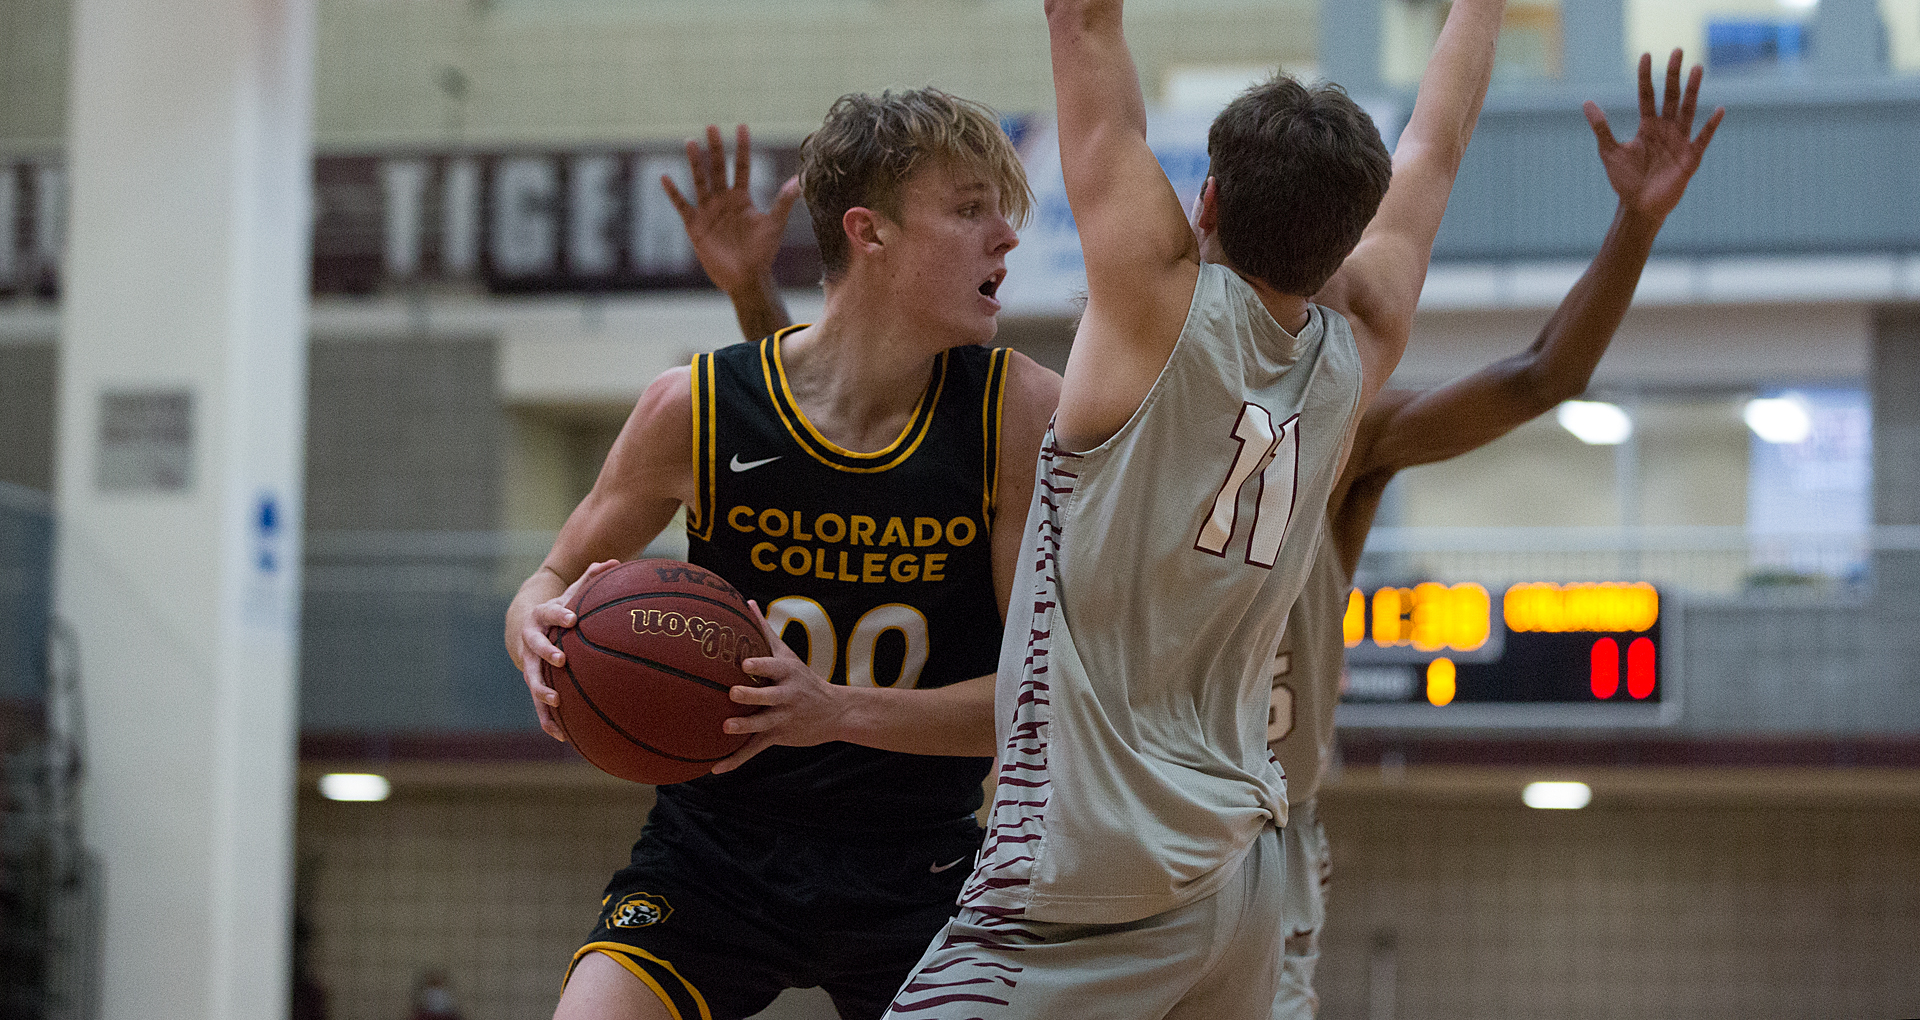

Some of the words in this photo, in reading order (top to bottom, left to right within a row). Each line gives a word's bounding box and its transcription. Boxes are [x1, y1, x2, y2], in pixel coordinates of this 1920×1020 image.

[1193, 401, 1300, 570] 11
[727, 505, 977, 548] COLORADO
[655, 567, 741, 600] CAA
[750, 541, 949, 583] COLLEGE
[766, 595, 930, 689] 00
